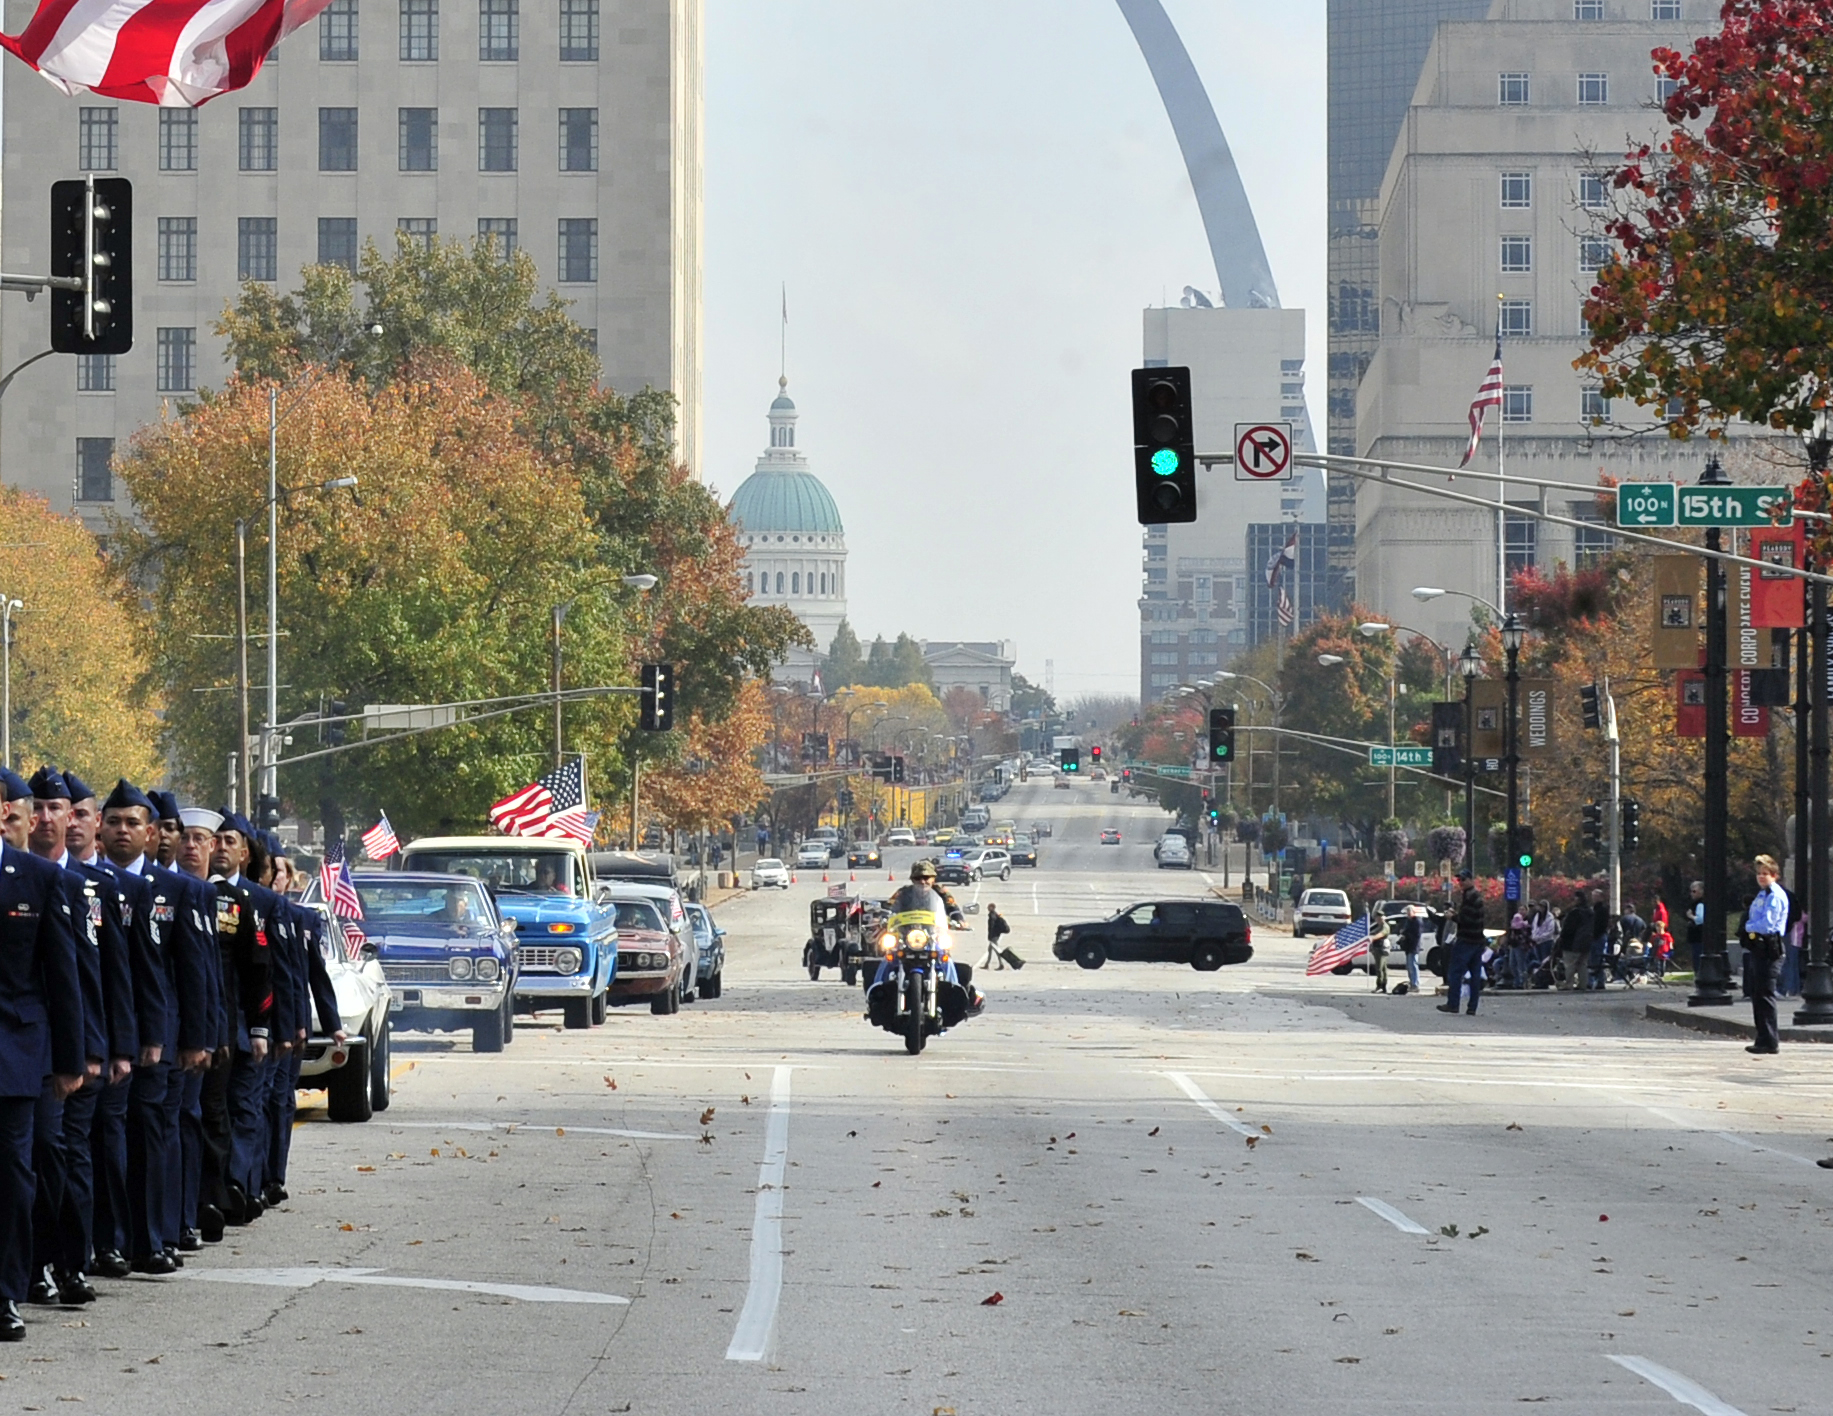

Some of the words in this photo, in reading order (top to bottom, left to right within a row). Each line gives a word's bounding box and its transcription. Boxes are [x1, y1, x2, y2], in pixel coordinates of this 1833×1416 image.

[1627, 497, 1659, 512] 100
[1682, 495, 1742, 518] 15th
[1529, 690, 1547, 747] WEDDINGS
[1396, 751, 1422, 762] 14th
[1427, 751, 1434, 762] S
